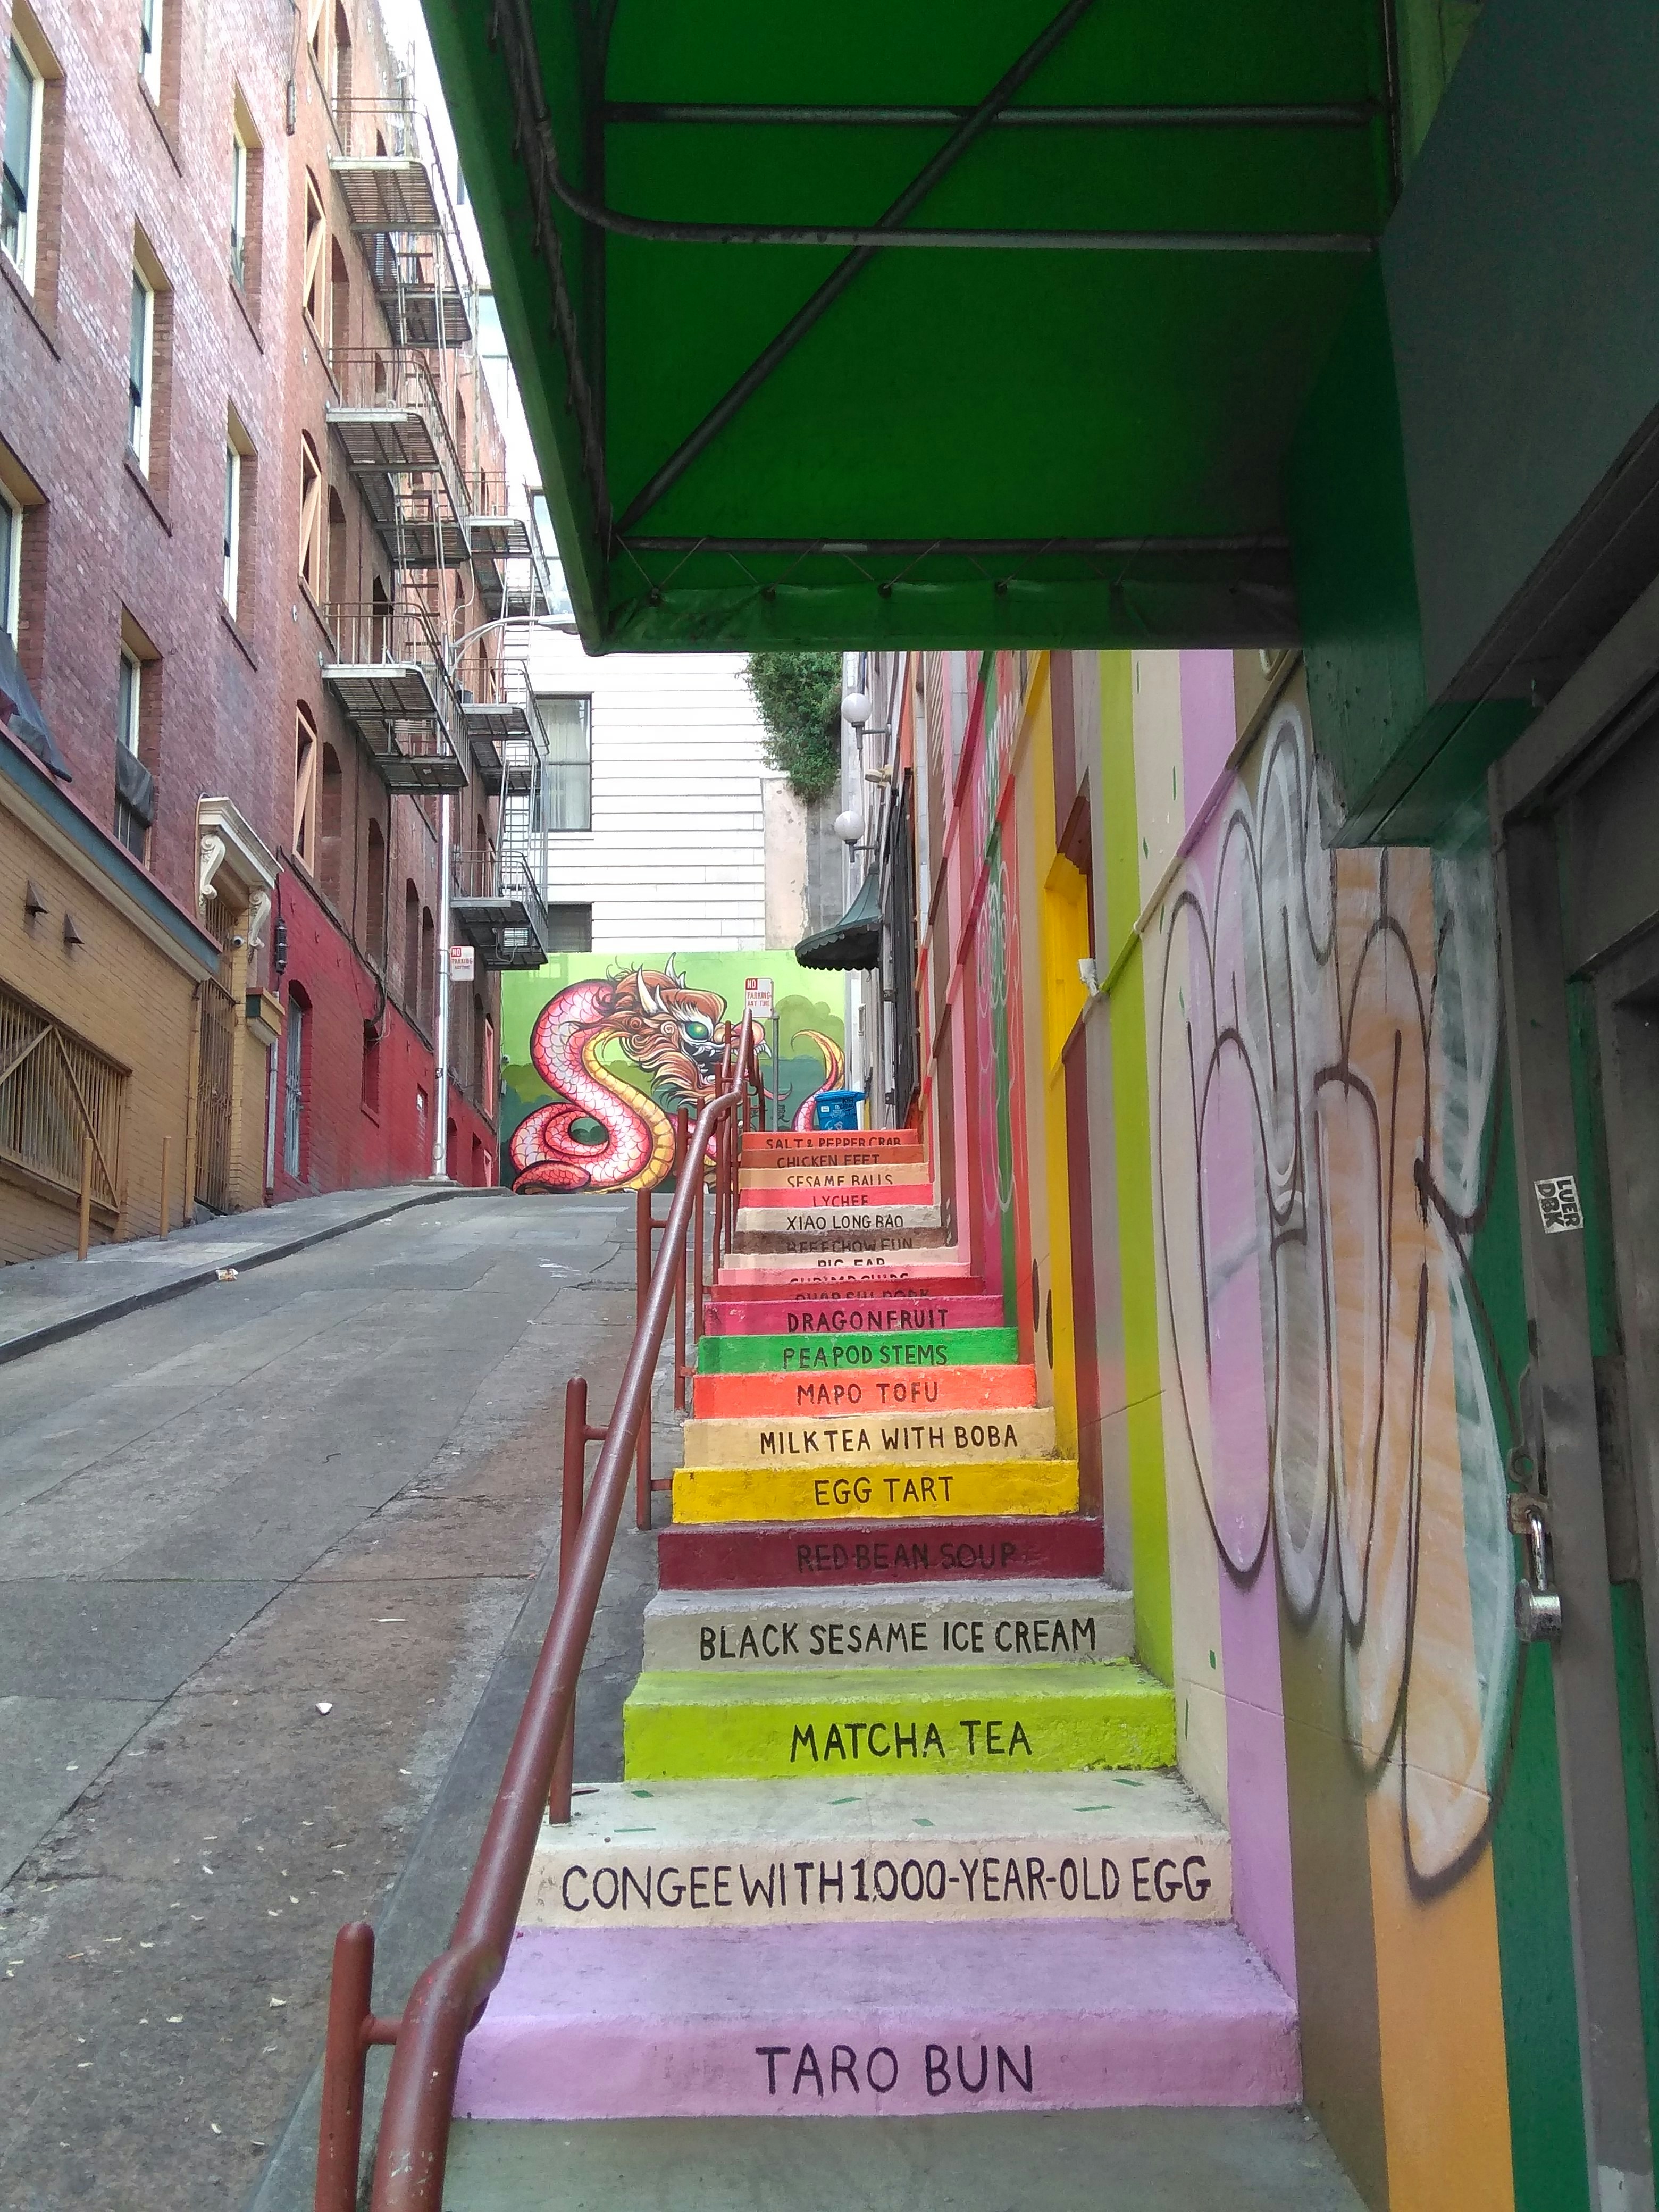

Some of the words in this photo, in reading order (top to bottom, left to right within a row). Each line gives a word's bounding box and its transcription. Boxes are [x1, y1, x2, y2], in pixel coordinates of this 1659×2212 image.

[747, 979, 756, 989] NO
[766, 1138, 803, 1149] SALT
[807, 1139, 814, 1147] &
[819, 1137, 865, 1147] PEPPER
[777, 1154, 837, 1168] CHICKEN
[844, 1154, 880, 1166] FEET
[787, 1175, 844, 1188] SESAME
[813, 1194, 868, 1208] LYCHEE
[1556, 1179, 1580, 1227] LUER
[786, 1216, 826, 1230] XIAO
[833, 1215, 872, 1229] LONG
[876, 1214, 903, 1228] BAO
[787, 1309, 948, 1333] DRAGONFRUIT
[879, 1344, 948, 1365] STEMS
[797, 1383, 861, 1406] MAPO
[876, 1382, 938, 1404] TOFU
[760, 1431, 819, 1455] MILK
[824, 1429, 870, 1452] TEA
[881, 1426, 944, 1450] WITH
[957, 1423, 1018, 1449] BOBA
[815, 1476, 872, 1506] EGG
[883, 1475, 954, 1503] TART
[798, 1544, 849, 1573] RED
[855, 1543, 929, 1570] BEAN
[940, 1542, 1016, 1569] SOUP
[700, 1622, 800, 1661] BLACK
[809, 1622, 927, 1655] SESAME
[943, 1621, 985, 1653] ICE
[995, 1618, 1096, 1653] CREAM
[790, 1721, 945, 1763] MATCHA
[959, 1719, 1033, 1756] TEA
[562, 1865, 732, 1911] CONGEE
[740, 1860, 843, 1908] WITH
[1132, 1855, 1211, 1903] EGG
[755, 2043, 899, 2098] TARO
[925, 2044, 1034, 2097] BUN
